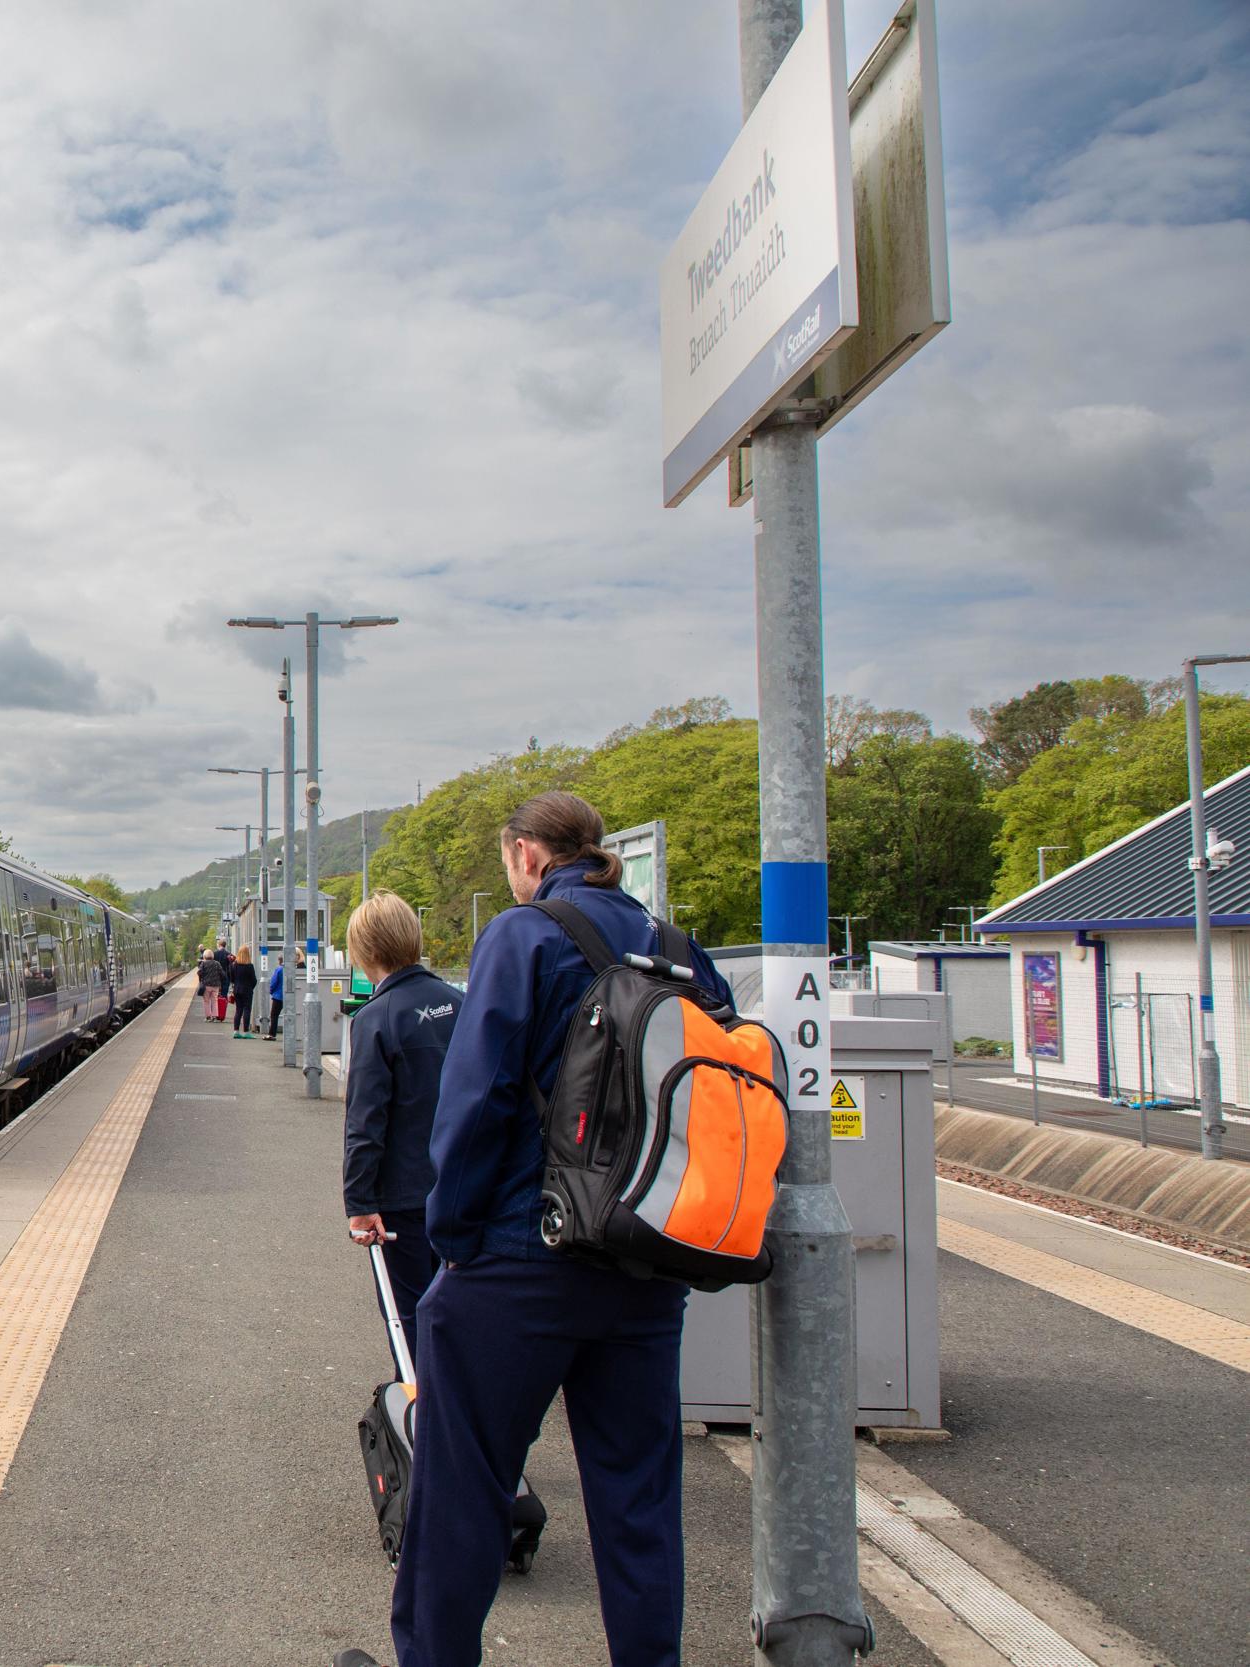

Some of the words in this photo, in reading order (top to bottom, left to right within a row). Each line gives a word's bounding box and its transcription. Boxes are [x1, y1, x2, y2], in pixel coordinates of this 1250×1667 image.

[687, 147, 776, 313] Tweedbank
[689, 298, 728, 376] Bruach
[730, 221, 786, 321] Thuaidh
[787, 303, 821, 359] ScotRail
[429, 1003, 453, 1016] ScotRail
[831, 1114, 860, 1122] aution
